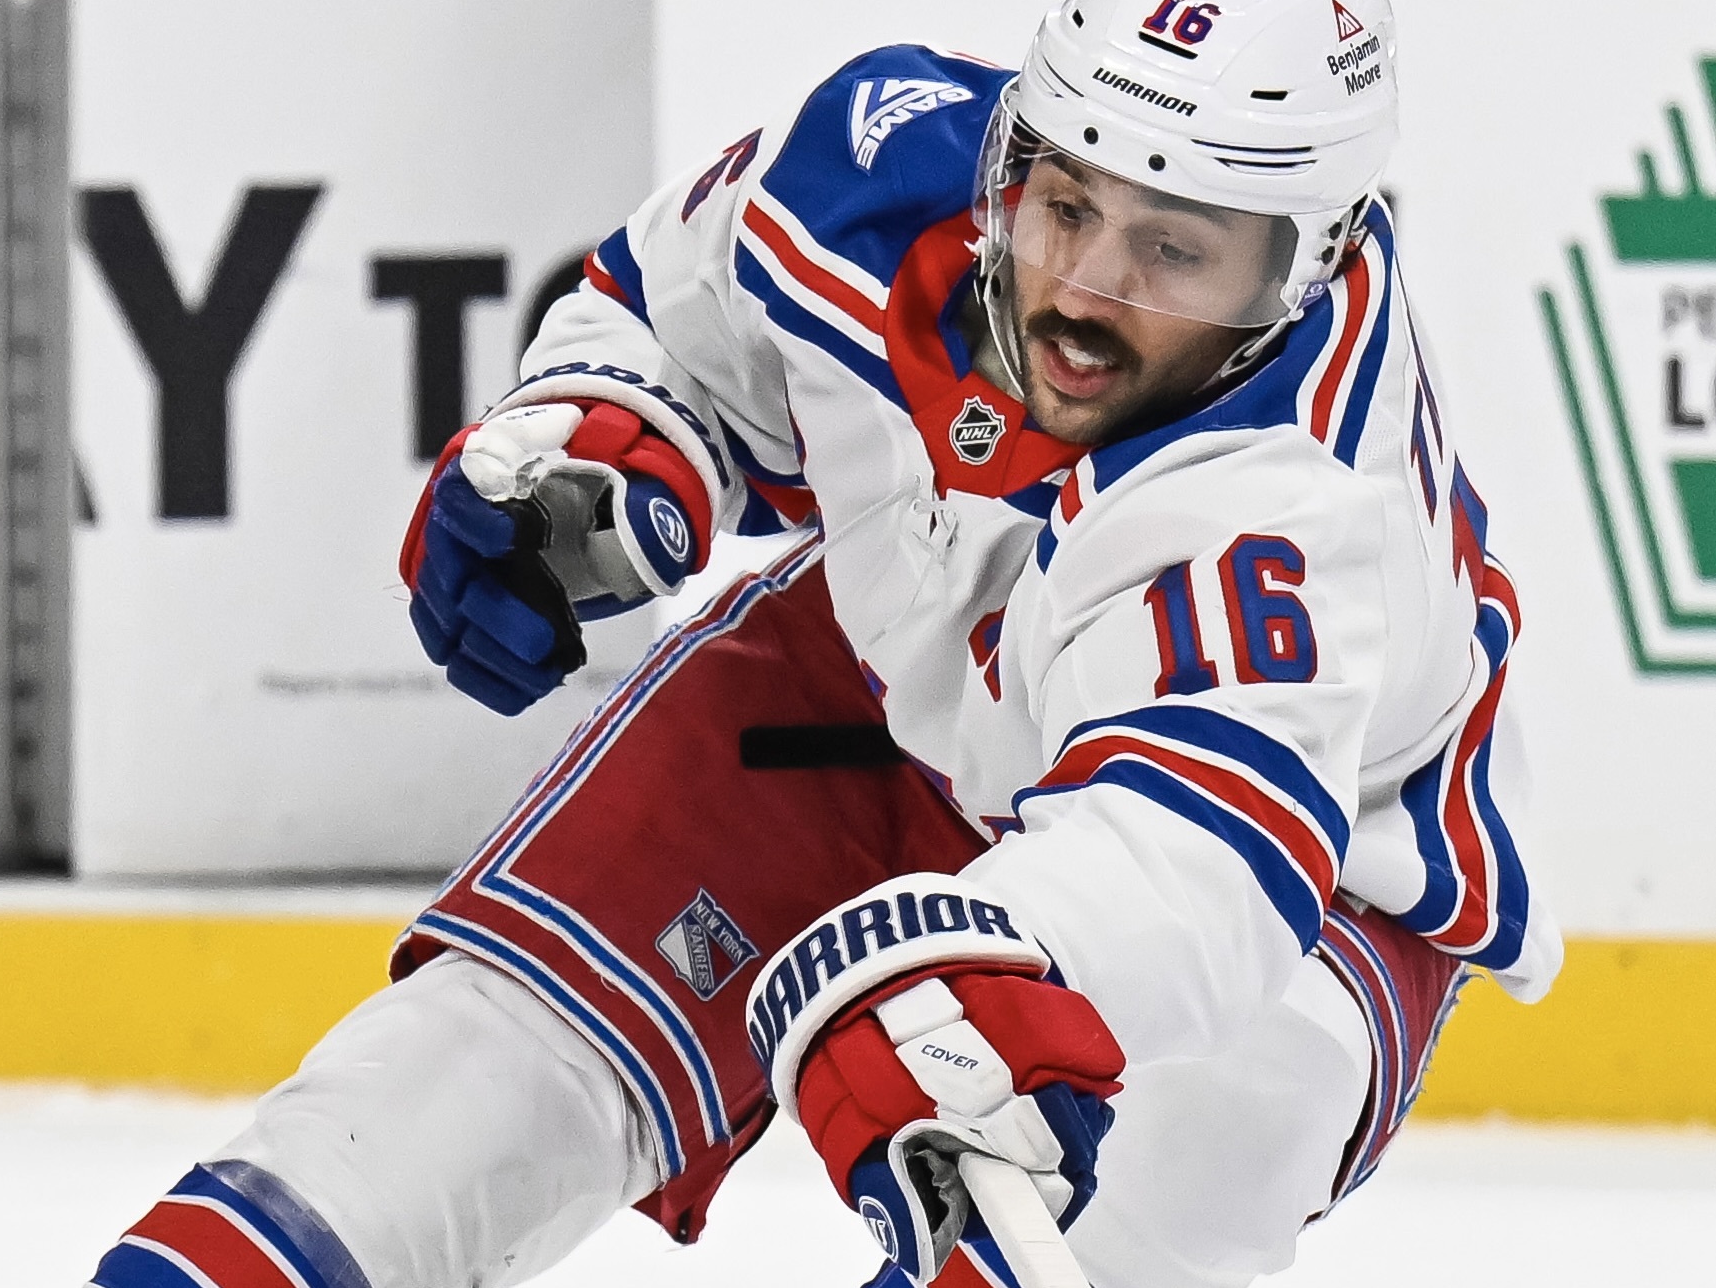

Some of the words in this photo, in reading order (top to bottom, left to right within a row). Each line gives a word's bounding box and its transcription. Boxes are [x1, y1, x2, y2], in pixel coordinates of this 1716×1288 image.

[1327, 32, 1380, 76] Benjamin
[1092, 67, 1198, 117] WARRIOR
[1344, 65, 1382, 97] Moore
[958, 427, 993, 441] NHL
[1146, 533, 1320, 697] 16
[692, 900, 720, 936] NEW
[717, 925, 745, 962] YORK
[687, 923, 714, 991] RANGERS
[920, 1044, 979, 1070] COVER
